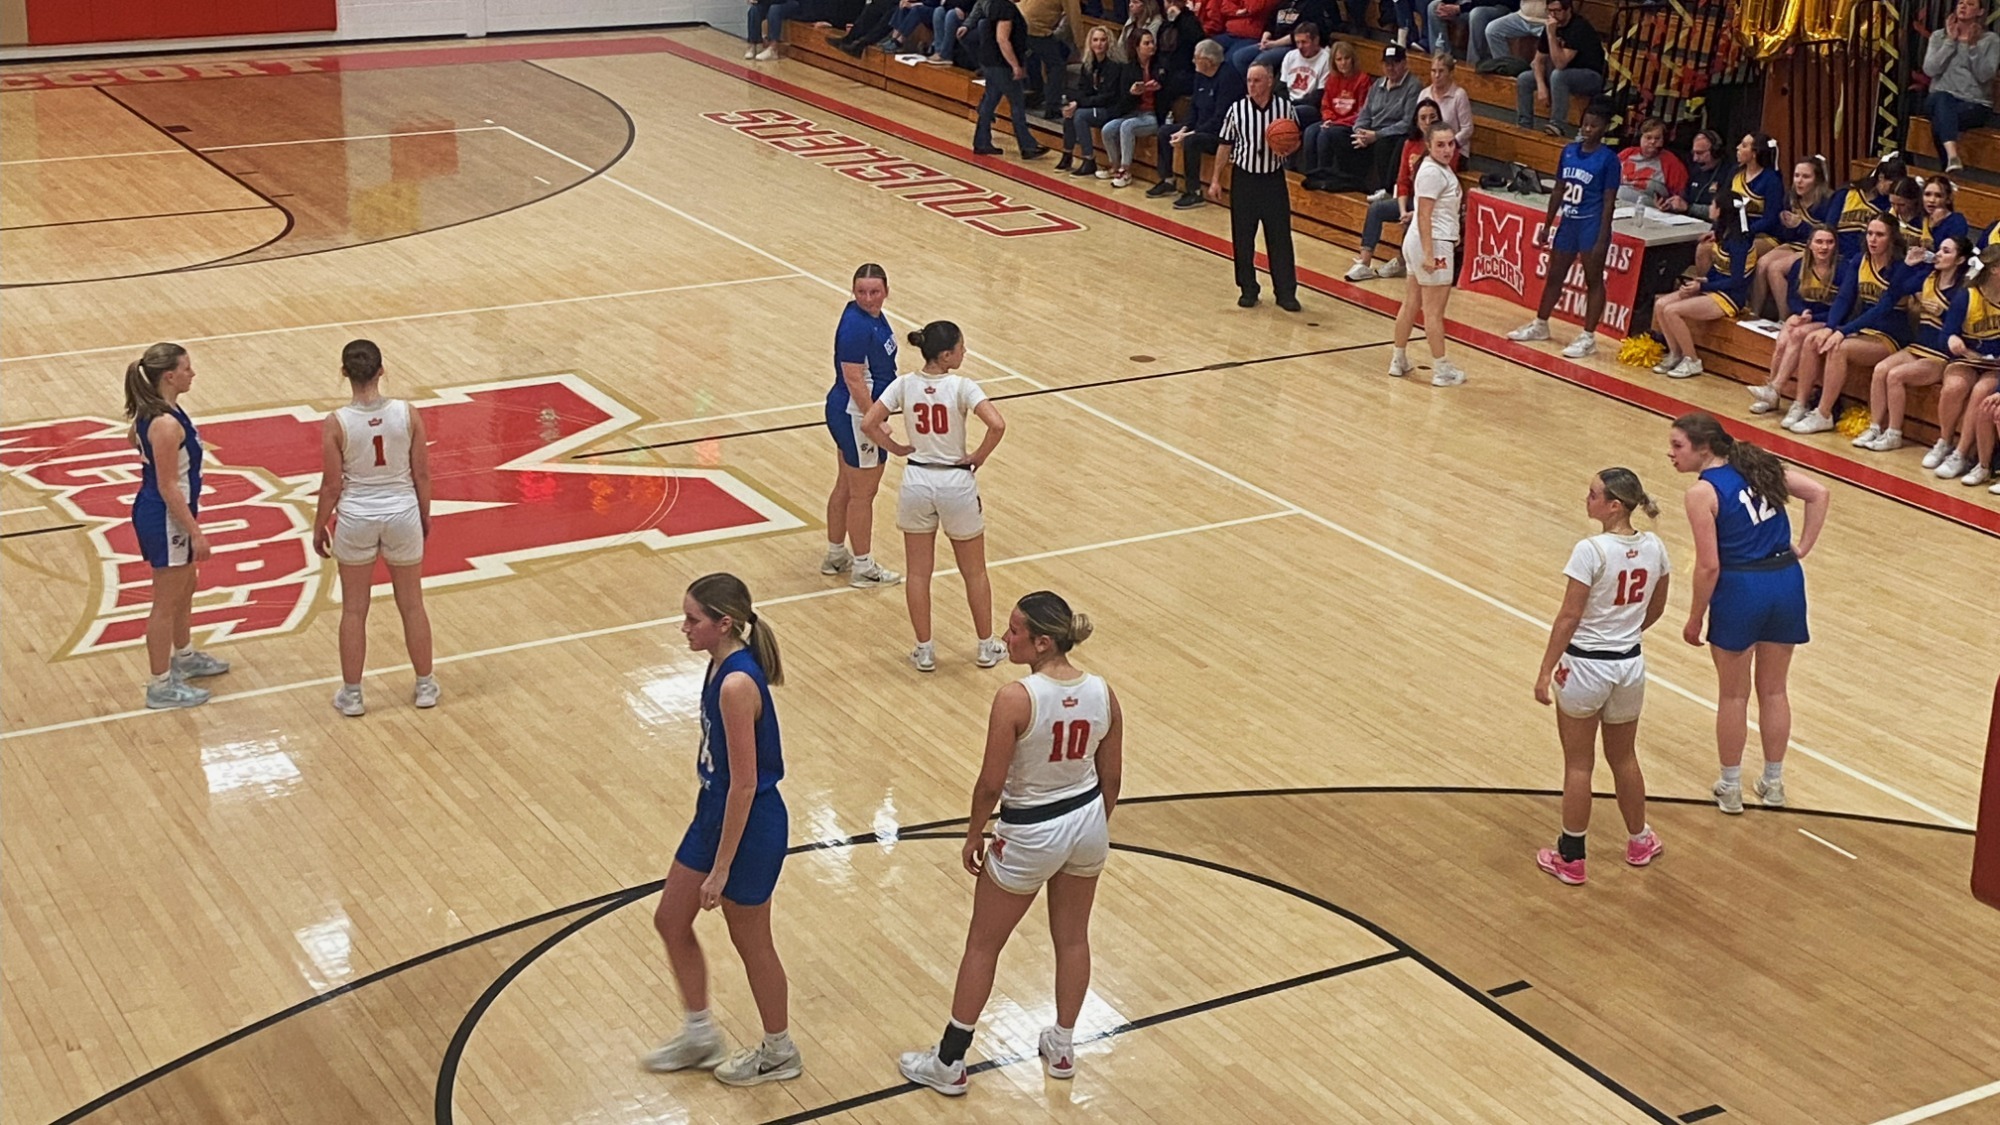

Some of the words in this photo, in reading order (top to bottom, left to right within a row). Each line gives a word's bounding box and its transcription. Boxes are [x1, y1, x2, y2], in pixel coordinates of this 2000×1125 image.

[1563, 182, 1583, 205] 20
[1478, 204, 1524, 272] M
[913, 402, 949, 435] 30
[372, 434, 387, 467] 1
[1739, 487, 1778, 527] 12
[1613, 568, 1649, 606] 12
[1048, 719, 1091, 763] 10
